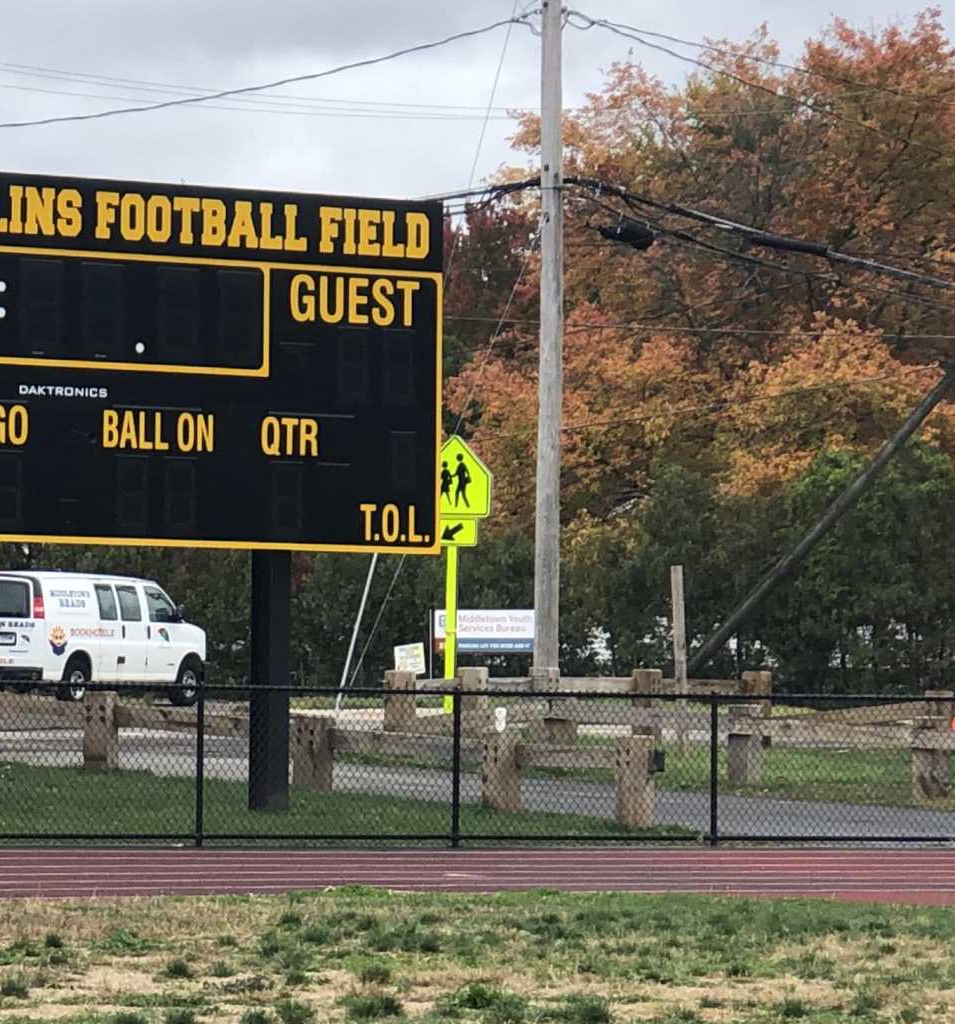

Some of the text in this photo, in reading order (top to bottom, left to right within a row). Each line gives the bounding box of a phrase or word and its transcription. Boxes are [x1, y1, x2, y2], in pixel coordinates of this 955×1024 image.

[95, 191, 308, 252] FOOTBALL
[319, 206, 431, 260] FIELD
[289, 274, 421, 327] GUEST
[18, 384, 108, 398] DAKTRONICS
[102, 409, 215, 452] BALL ON
[260, 416, 319, 457] QTR
[359, 503, 431, 544] T.O.L.
[458, 614, 507, 624] Middletown
[458, 624, 527, 633] Services Bureau
